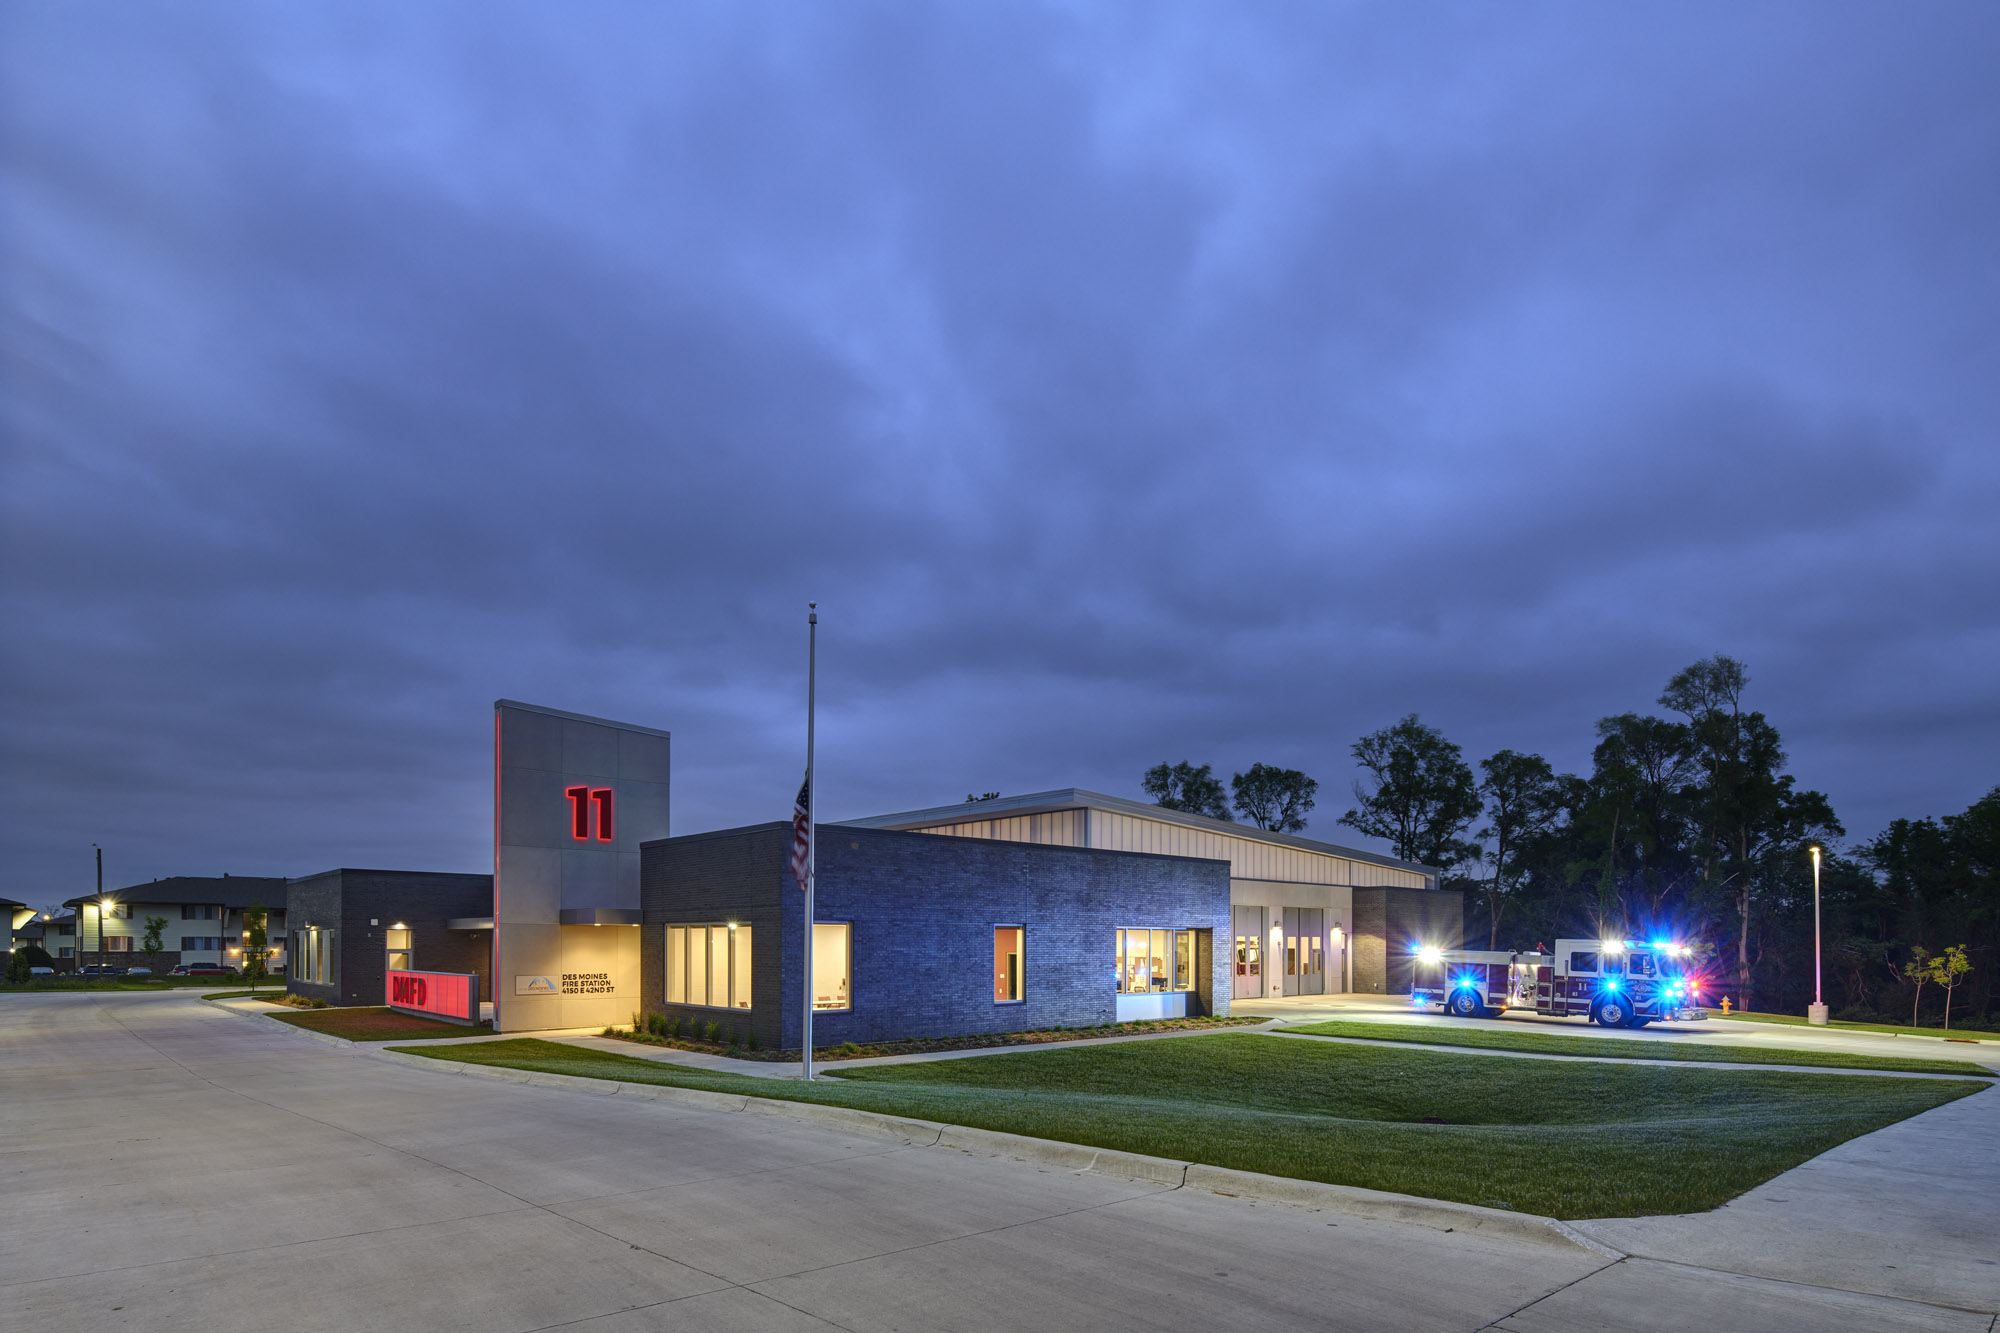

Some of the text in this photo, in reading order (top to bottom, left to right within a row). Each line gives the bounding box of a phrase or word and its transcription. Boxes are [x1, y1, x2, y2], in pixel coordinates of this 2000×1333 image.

[566, 786, 613, 841] 11
[392, 975, 427, 1006] DMFD
[585, 986, 605, 994] 42ND
[1578, 982, 1587, 991] 11
